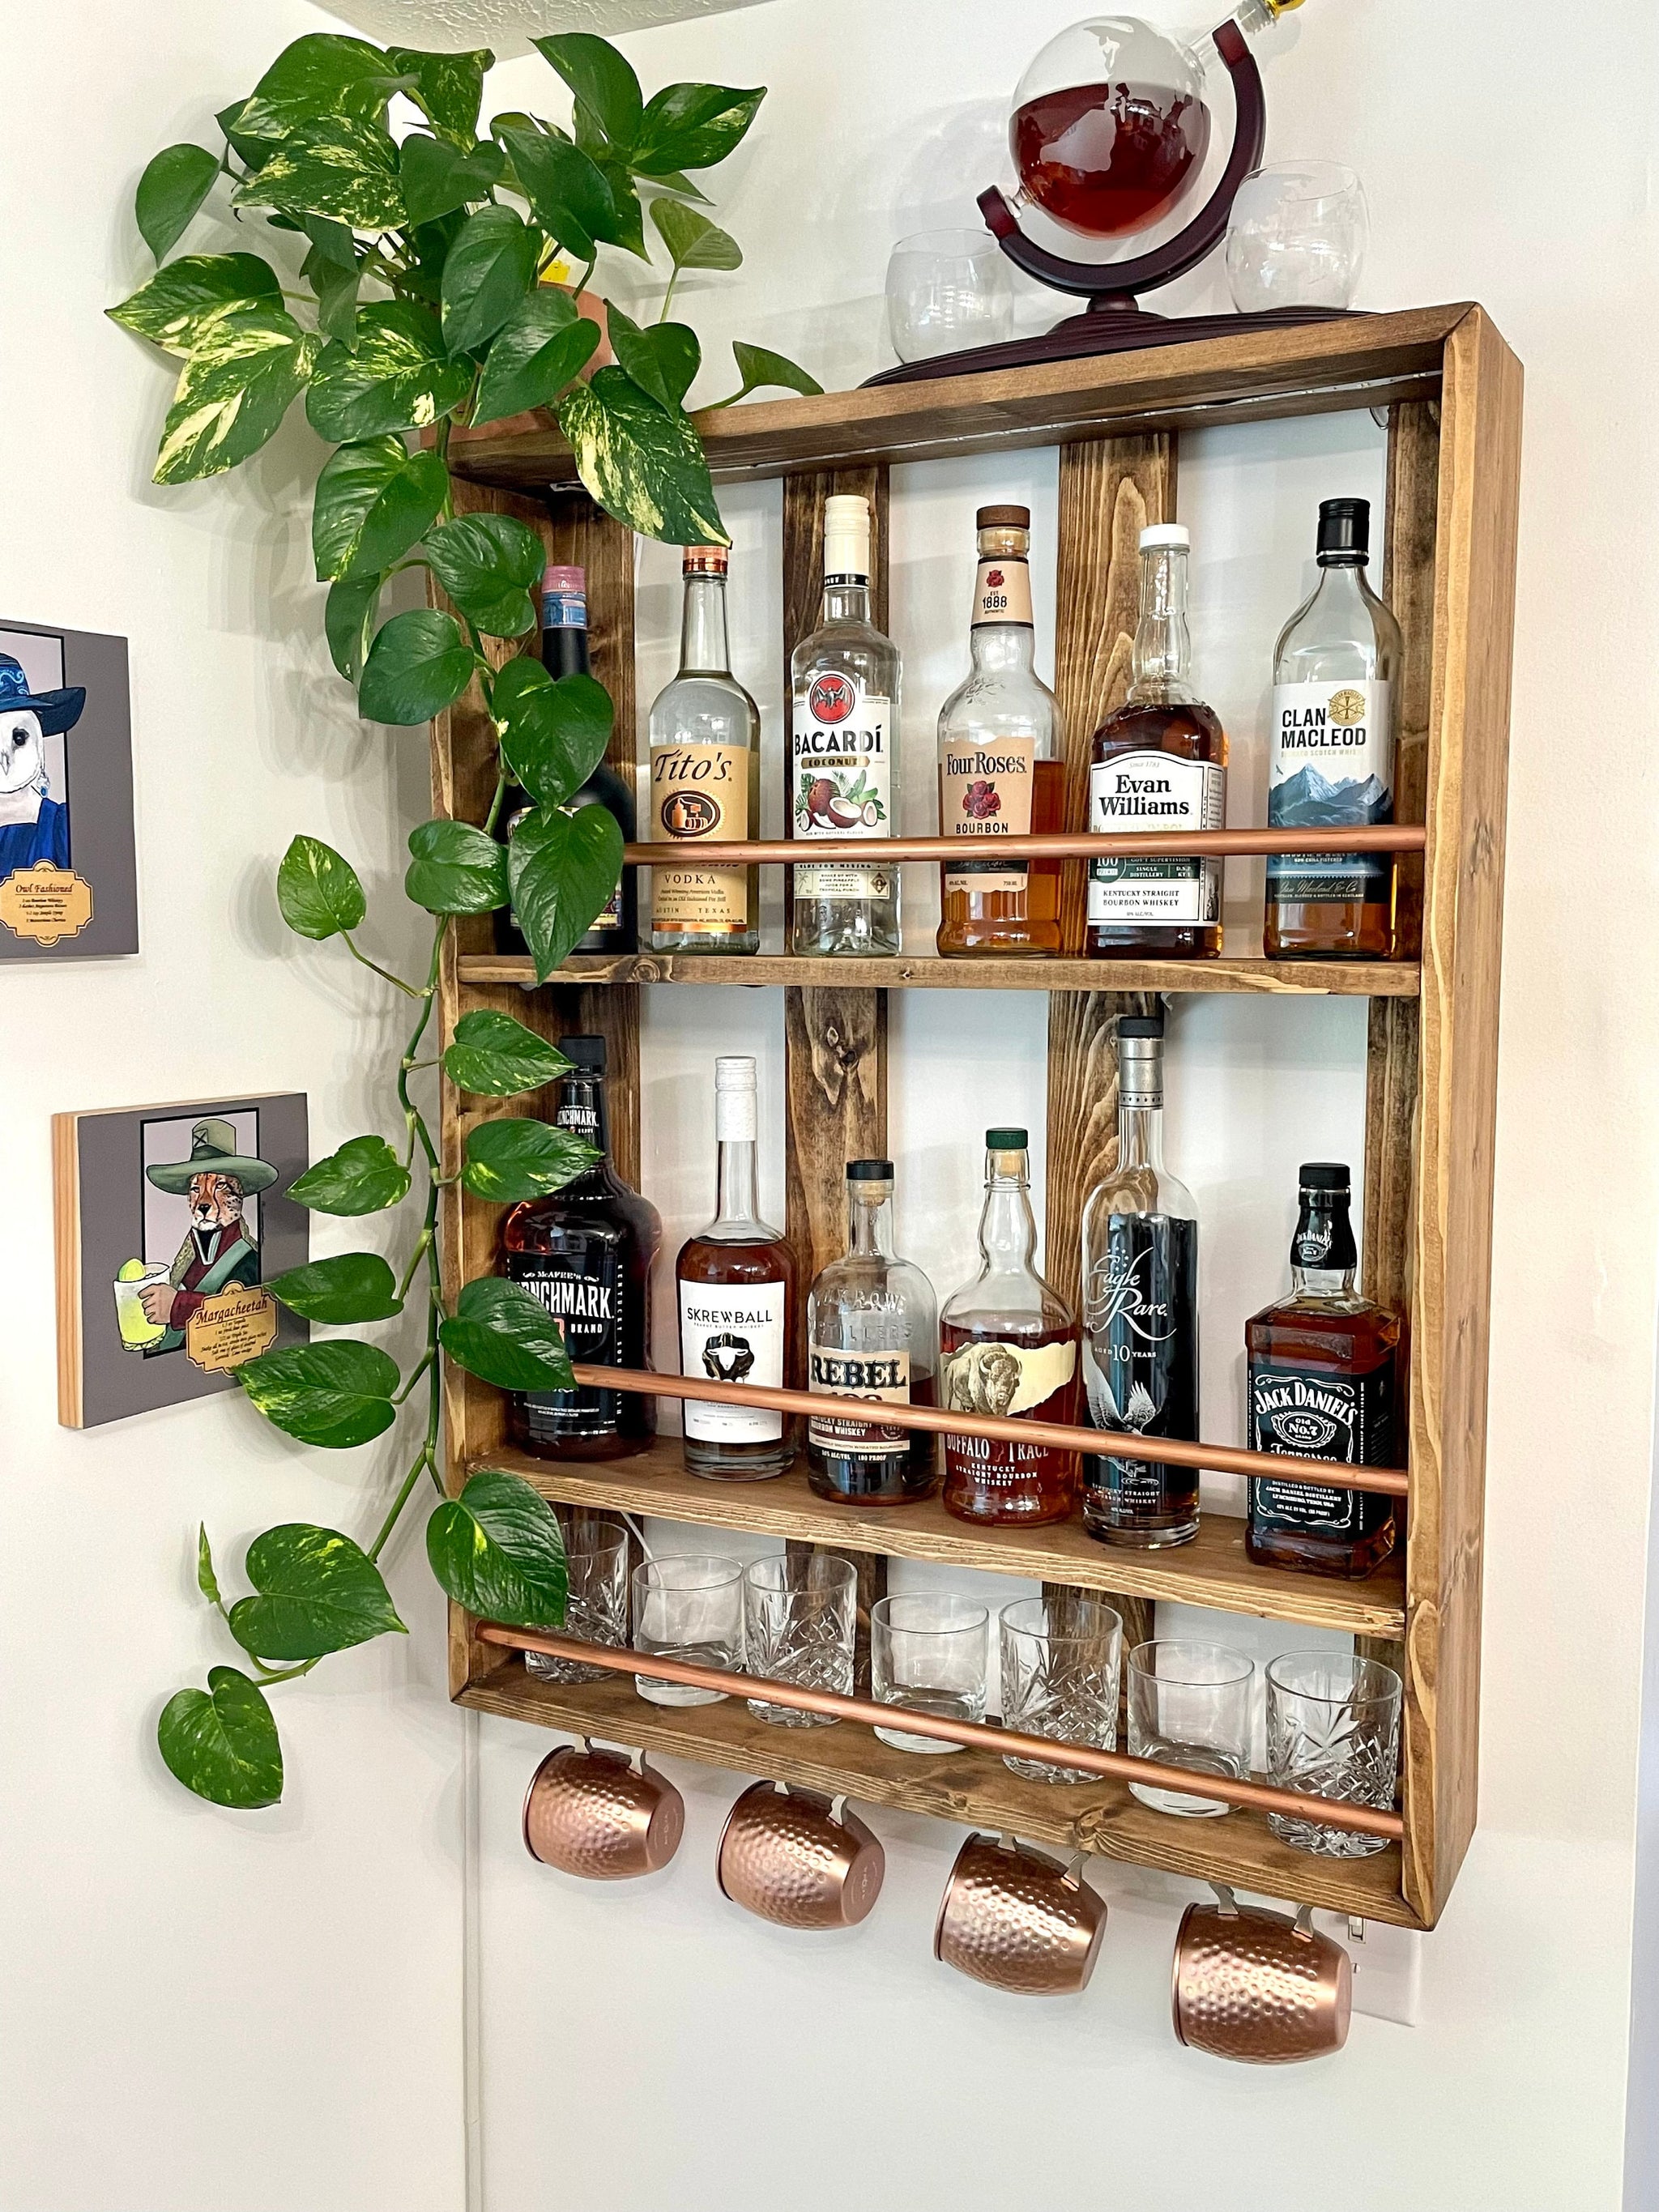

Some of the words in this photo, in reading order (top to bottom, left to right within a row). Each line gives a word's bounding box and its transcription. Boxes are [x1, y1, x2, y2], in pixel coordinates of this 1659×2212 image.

[983, 595, 1007, 609] 1888
[1282, 707, 1326, 728] CLAN
[795, 724, 881, 756] BACARDÍ
[1281, 727, 1367, 749] MACLEOD
[654, 748, 732, 782] Tito's
[808, 757, 858, 767] COCONUT
[946, 753, 975, 776] Four
[975, 752, 1026, 775] Roses
[1115, 774, 1171, 794] Evan
[1098, 796, 1190, 816] Williams
[956, 822, 1009, 834] BOURBON
[15, 884, 34, 893] Owl
[34, 883, 75, 893] Fashioned
[664, 875, 716, 884] VODKA
[537, 1271, 582, 1281] McAFEE'S
[516, 1281, 612, 1319] NCHMARK
[195, 1296, 268, 1326] Margacheetah
[687, 1306, 773, 1323] SKREWBALL
[1090, 1287, 1177, 1341] Rare
[570, 1323, 603, 1334] BRAND
[1094, 1347, 1113, 1355] AGED
[1113, 1344, 1131, 1362] 10
[810, 1353, 908, 1390] REBEL
[1254, 1387, 1294, 1415] JACK
[1294, 1381, 1358, 1426] DANIEL'S
[834, 1425, 866, 1437] WHISKEY
[946, 1434, 991, 1461] BUFFALO
[956, 1464, 992, 1479] STRAIGHT
[996, 1472, 1038, 1480] BOURBON
[971, 1462, 1016, 1473] KENTUCKY
[974, 1477, 1013, 1486] WHISKEY
[1272, 1480, 1299, 1489] DISTILLED
[1303, 1485, 1327, 1494] BOTTLED
[1282, 1488, 1304, 1497] DANIEL
[1304, 1491, 1342, 1502] DISTILLERY
